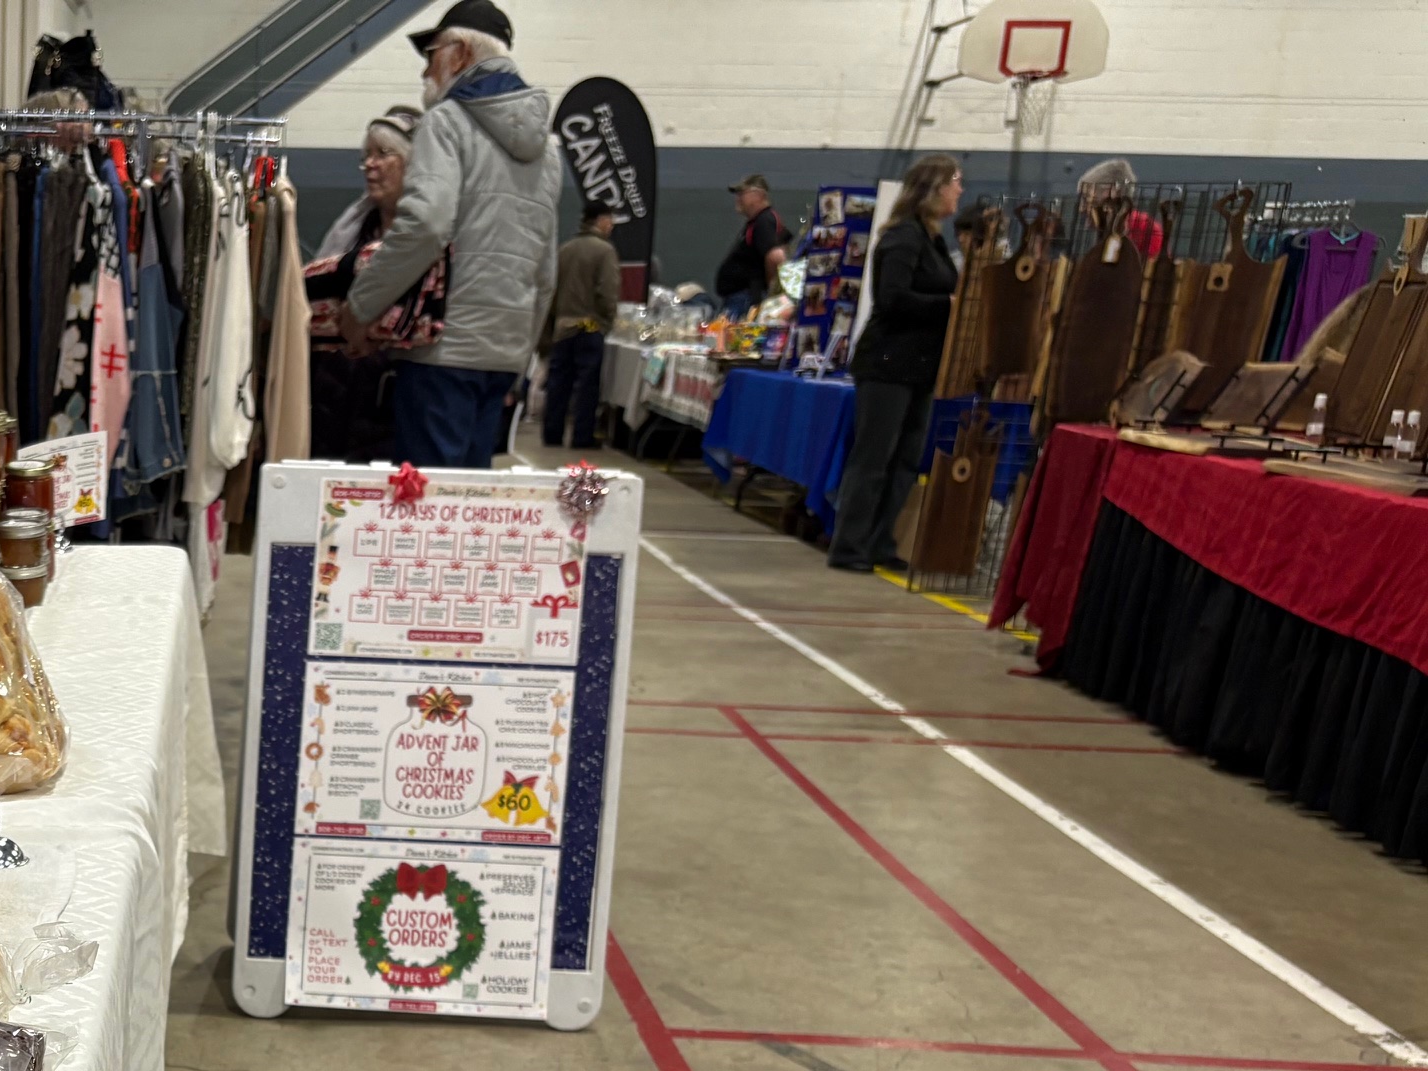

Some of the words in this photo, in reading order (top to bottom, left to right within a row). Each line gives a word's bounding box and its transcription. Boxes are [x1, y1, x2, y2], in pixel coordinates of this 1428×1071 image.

[593, 102, 628, 166] FREEZE
[620, 166, 647, 218] DRIED
[379, 504, 396, 520] 12
[397, 504, 436, 522] DAYS
[440, 504, 459, 522] OF
[462, 506, 543, 526] CHRISTMAS
[534, 630, 570, 648] $175
[396, 732, 448, 750] ADVENT
[452, 736, 479, 752] JAR
[426, 751, 446, 768] OF
[396, 766, 474, 785] CHRISTMAS
[402, 783, 465, 801] COOKIES
[416, 802, 467, 816] COOKIES
[498, 792, 532, 812] $60
[386, 910, 452, 929] CUSTOM
[498, 912, 535, 922] BAKING
[310, 928, 335, 938] CALL
[388, 928, 448, 948] ORDERS
[324, 939, 348, 948] TEXT
[309, 947, 322, 956] TO
[308, 956, 340, 966] PLACE
[307, 965, 336, 975] YOUR
[388, 970, 401, 982] BY
[404, 971, 425, 984] DEC.
[306, 974, 344, 984] ORDER
[488, 976, 529, 986] HOLIDAY
[486, 986, 528, 994] COOKIES
